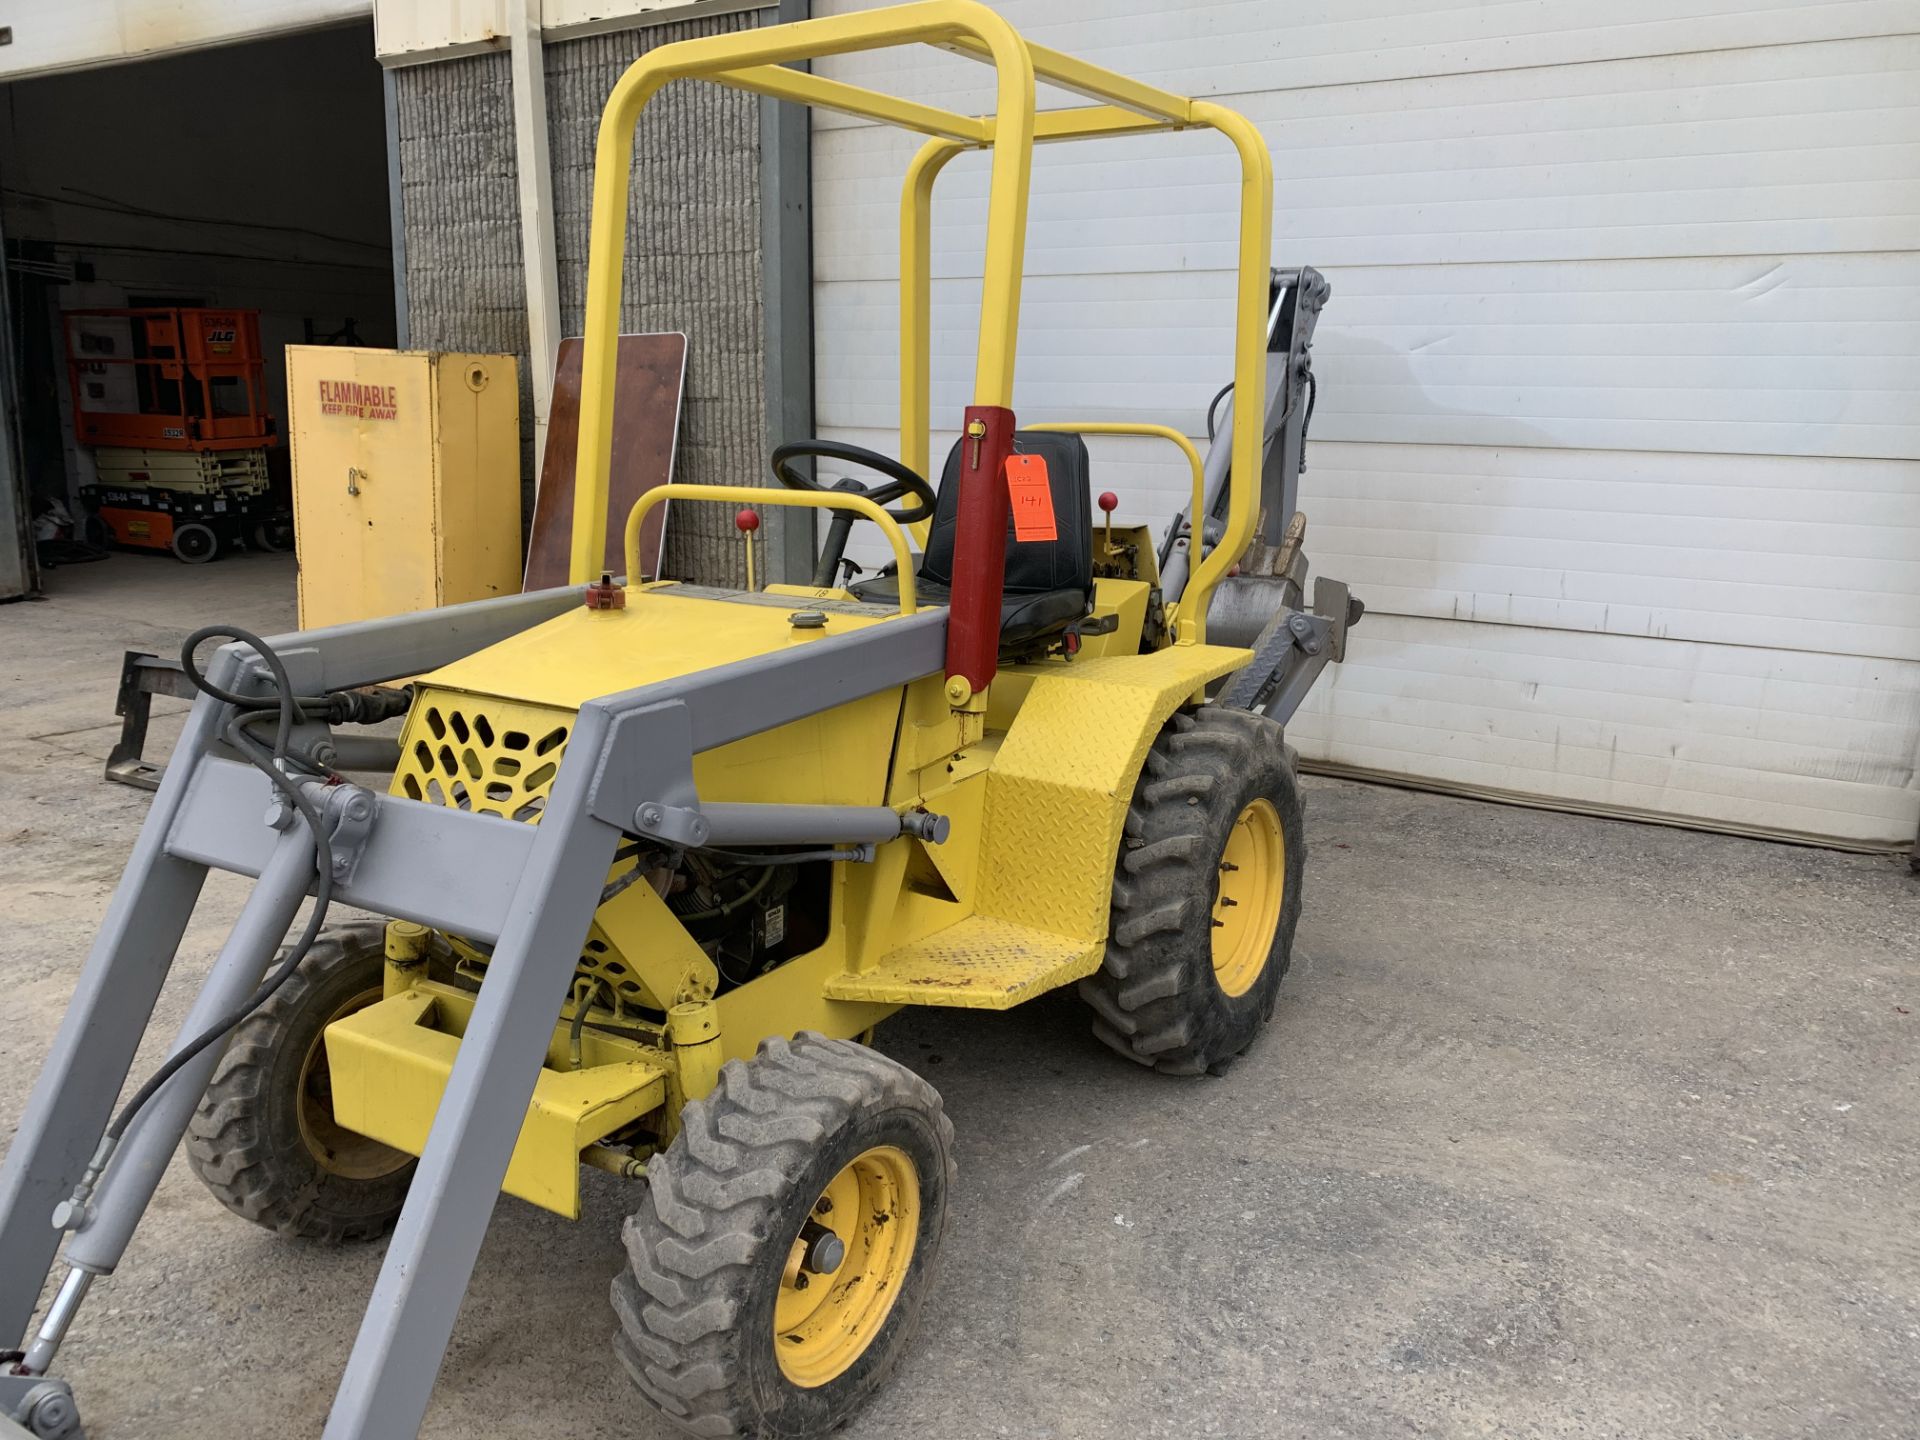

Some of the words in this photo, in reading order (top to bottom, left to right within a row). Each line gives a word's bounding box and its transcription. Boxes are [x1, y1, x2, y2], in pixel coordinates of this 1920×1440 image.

[207, 330, 235, 342] JLG
[319, 381, 397, 408] FLAMMABLE
[322, 403, 342, 415] KEEP
[345, 405, 364, 418] FIRE
[369, 407, 397, 420] AWAY
[1021, 495, 1042, 507] 141
